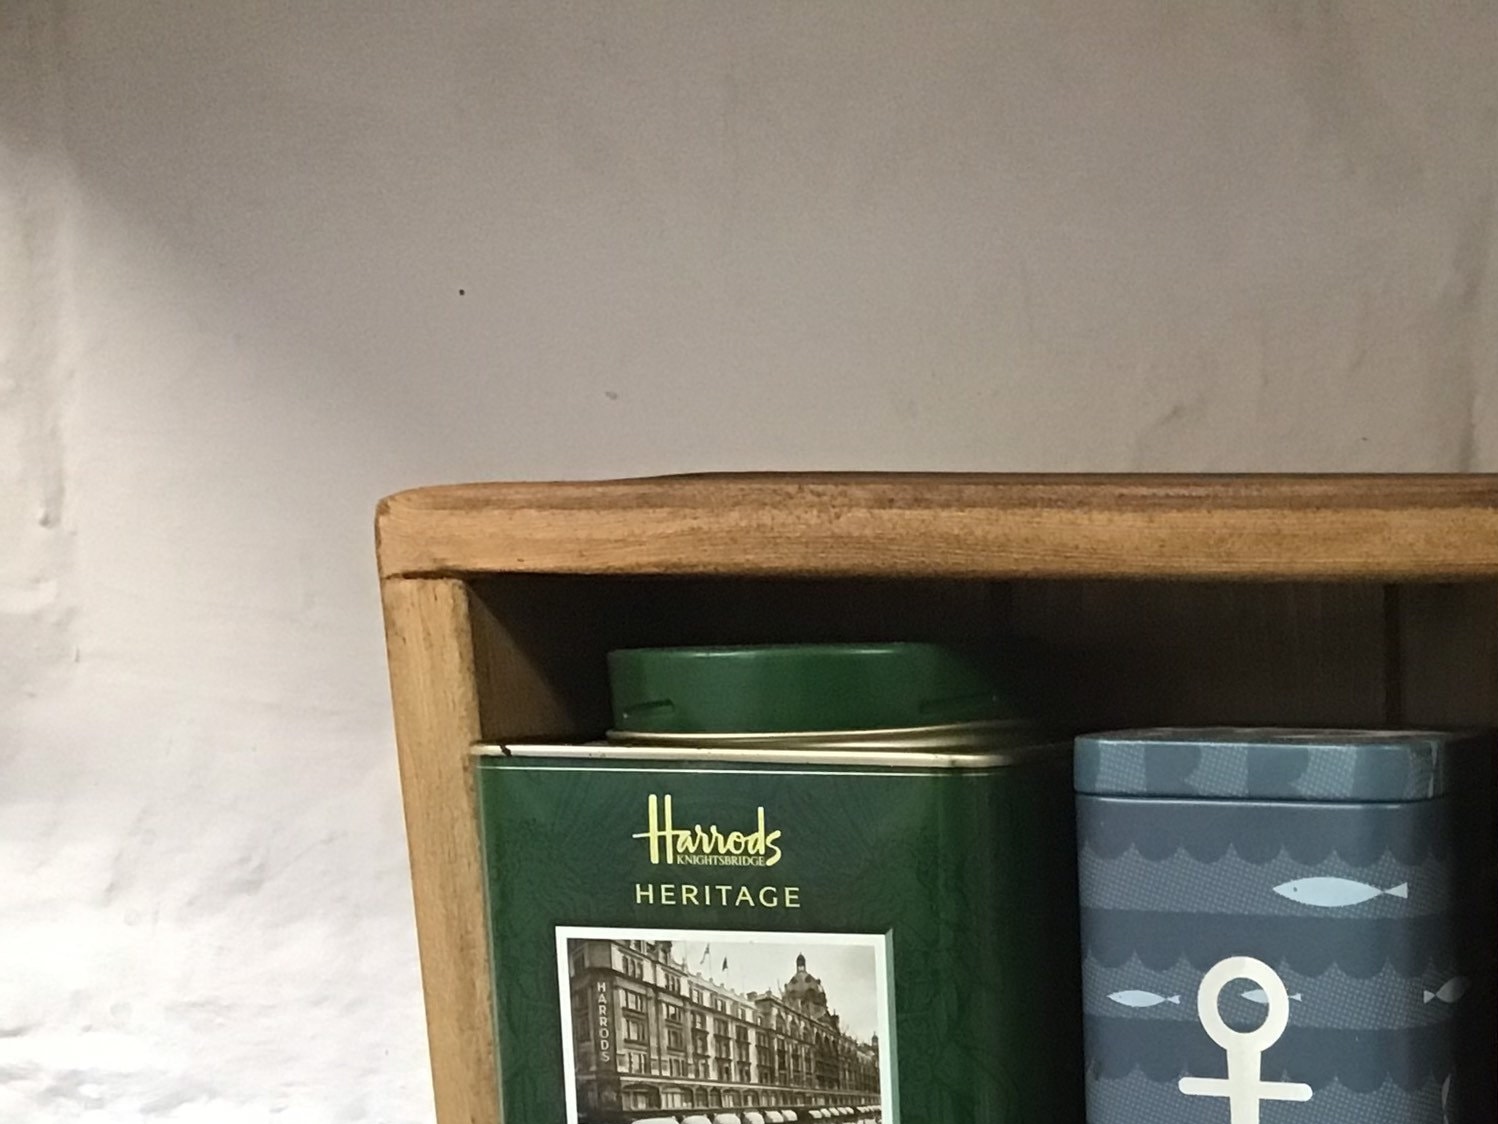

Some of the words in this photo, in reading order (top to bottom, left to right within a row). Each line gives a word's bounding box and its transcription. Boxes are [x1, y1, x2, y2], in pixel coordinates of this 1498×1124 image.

[632, 793, 782, 867] Harrods
[677, 854, 767, 867] KNIGHTSBRIDGE
[635, 883, 801, 908] HERITAGE
[597, 981, 610, 1062] HARRODS
